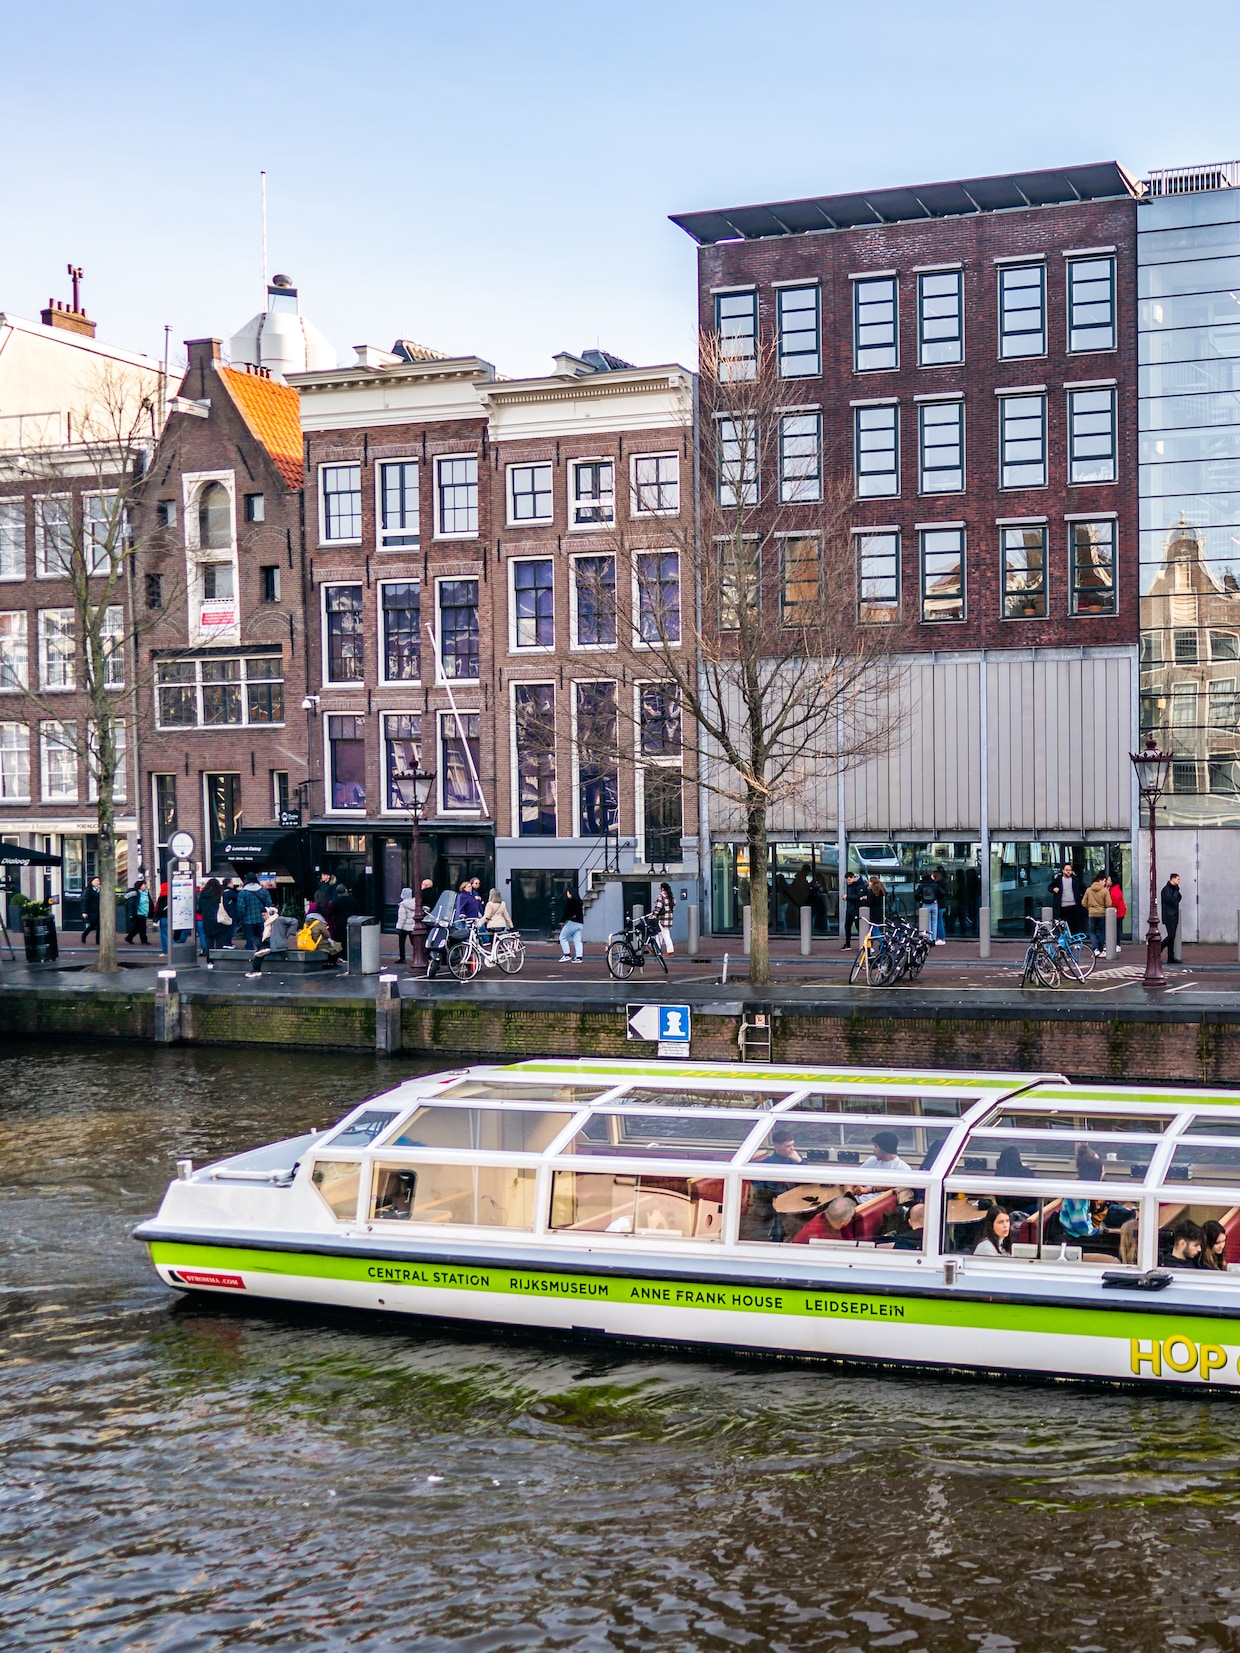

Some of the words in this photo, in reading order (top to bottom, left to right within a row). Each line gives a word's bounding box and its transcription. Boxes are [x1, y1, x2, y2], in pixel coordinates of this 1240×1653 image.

[1, 857, 31, 866] Dialoog
[678, 1070, 759, 1079] HOP
[760, 1073, 821, 1081] ON
[831, 1075, 914, 1084] HOP
[916, 1079, 986, 1087] OFF
[368, 1267, 429, 1282] CENTRAL
[433, 1272, 490, 1287] STATION
[510, 1278, 609, 1296] RIJKSMUSEUM
[630, 1287, 671, 1301] ANNE
[676, 1290, 727, 1304] FRANK
[732, 1295, 784, 1309] HOUSE
[1130, 1334, 1227, 1380] HOP
